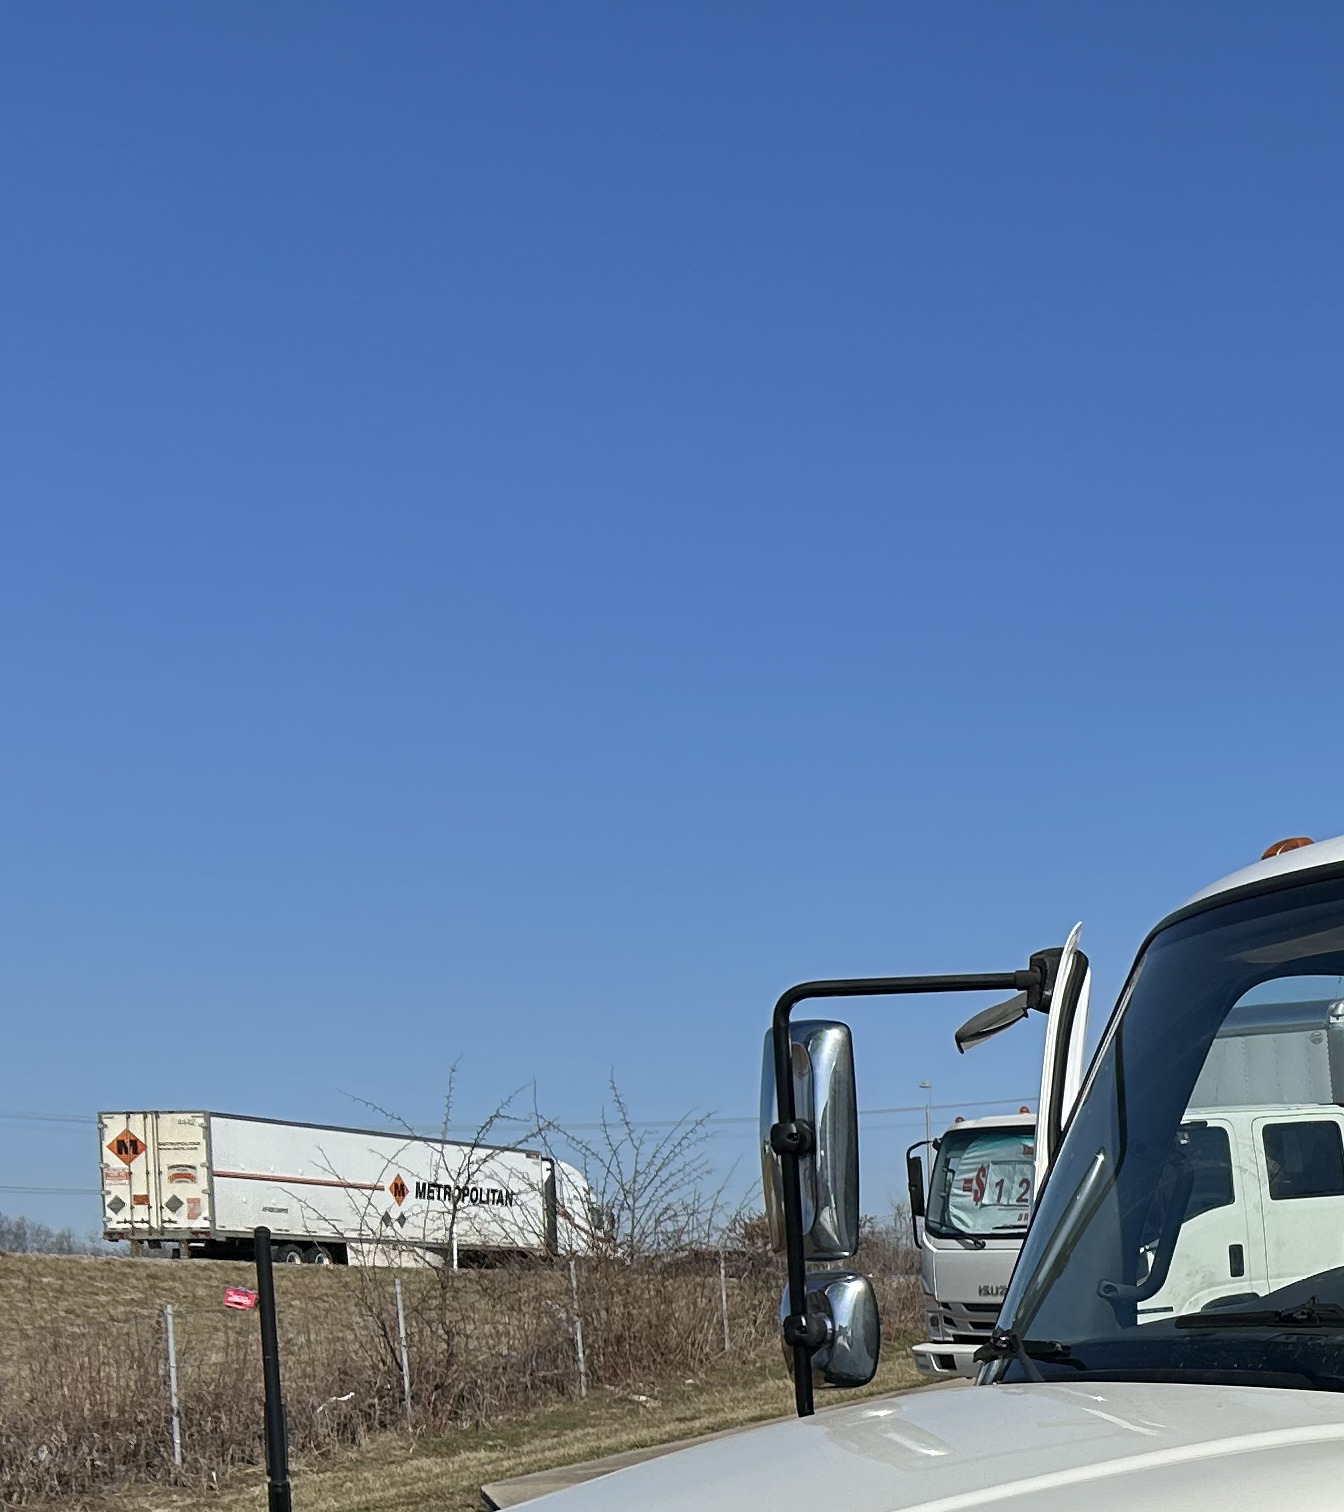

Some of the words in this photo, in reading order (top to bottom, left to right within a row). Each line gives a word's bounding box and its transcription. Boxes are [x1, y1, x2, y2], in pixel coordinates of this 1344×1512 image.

[117, 1140, 139, 1155] M
[393, 1179, 406, 1198] M
[415, 1181, 514, 1207] METROPOLITAN
[978, 1284, 1008, 1297] ISUZ
